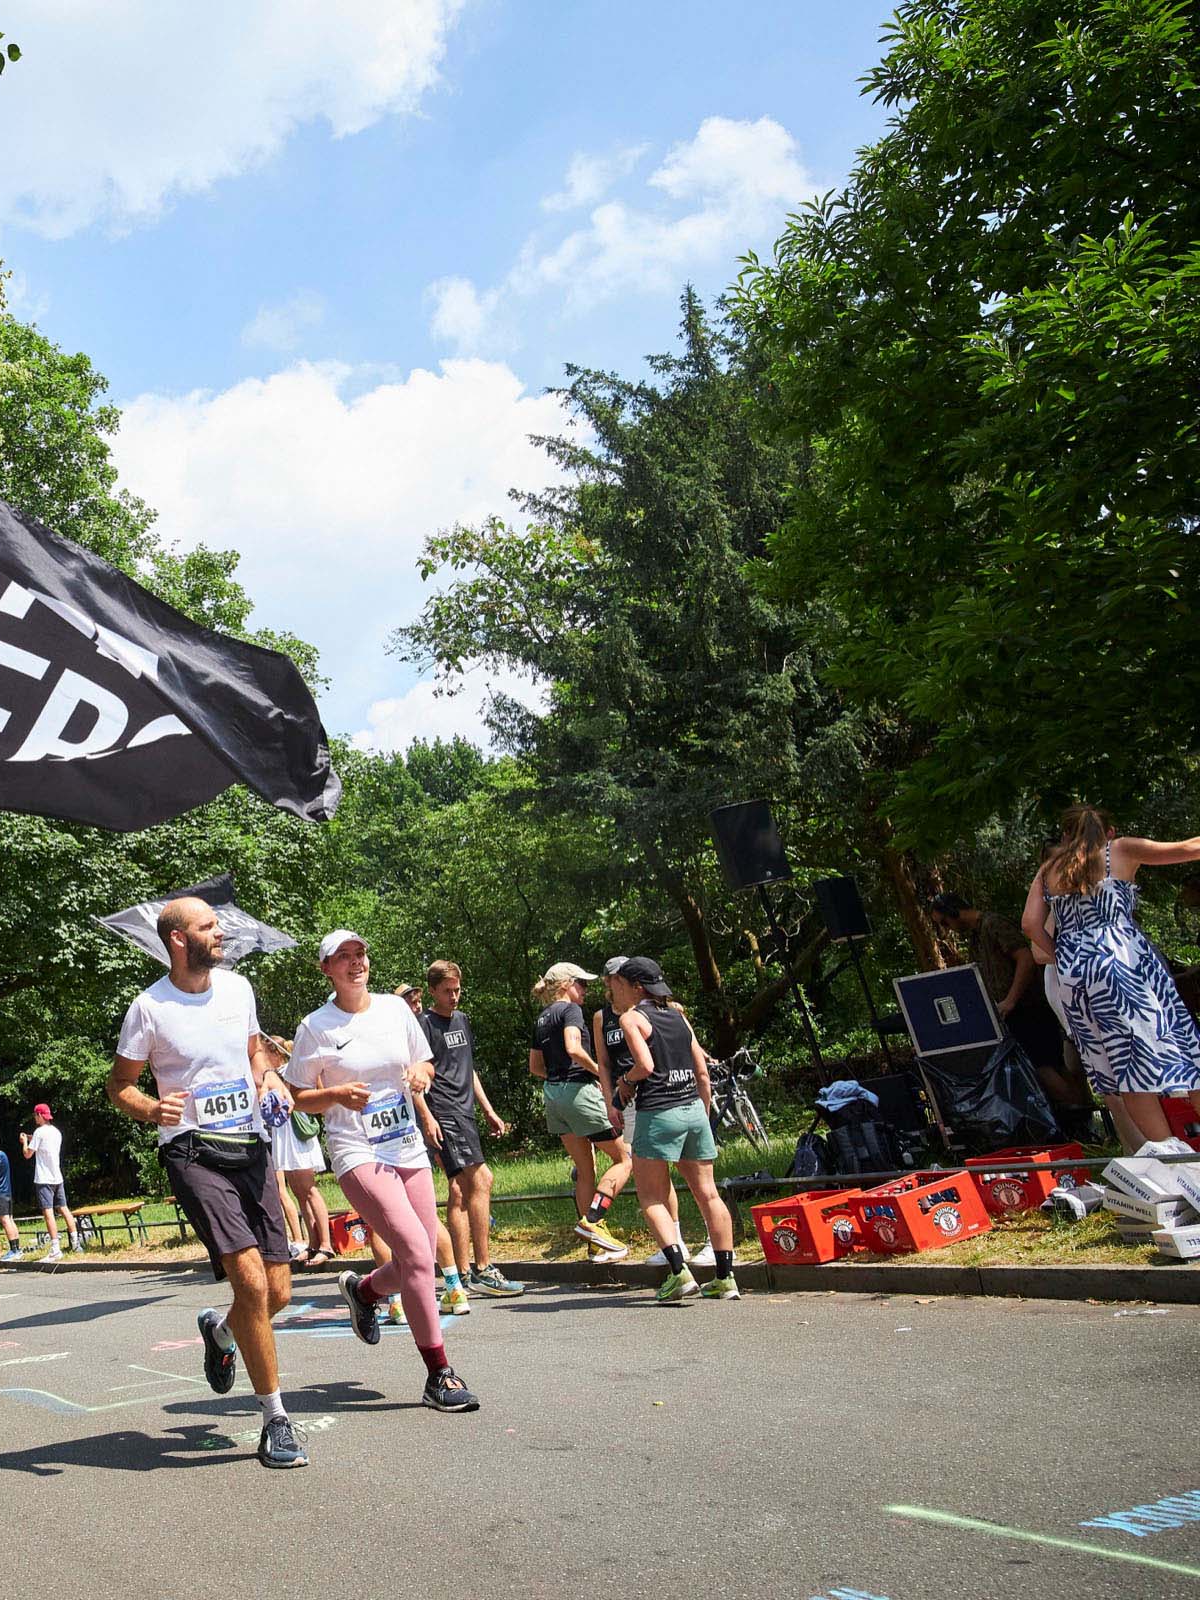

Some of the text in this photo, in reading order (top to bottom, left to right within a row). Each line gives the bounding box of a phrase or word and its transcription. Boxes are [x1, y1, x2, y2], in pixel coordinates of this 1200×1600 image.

[204, 1091, 249, 1116] 4613
[371, 1105, 410, 1129] 4614
[1110, 1167, 1152, 1202] VITAMIN WELL
[1106, 1196, 1153, 1217] VITAMIN WELL
